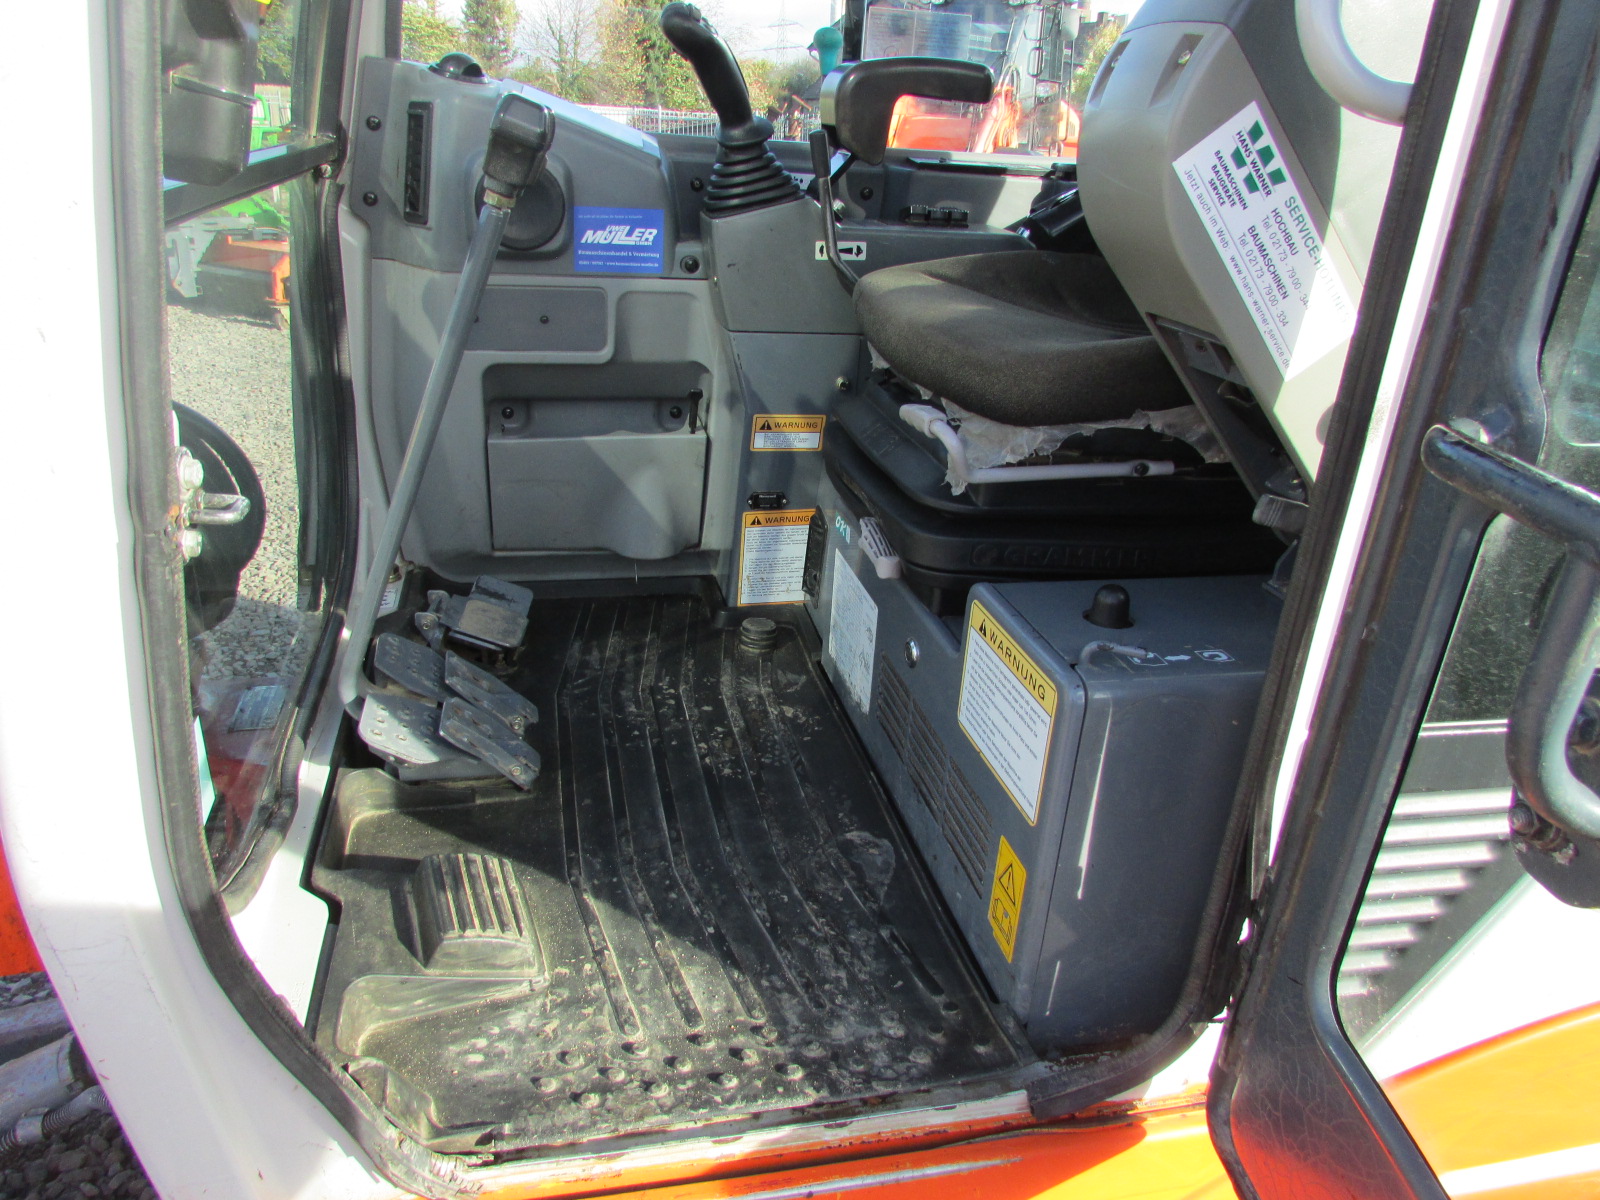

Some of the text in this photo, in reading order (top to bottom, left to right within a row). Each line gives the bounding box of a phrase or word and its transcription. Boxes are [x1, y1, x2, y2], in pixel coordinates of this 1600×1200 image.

[1210, 162, 1238, 208] BAUGERÄTE
[1213, 149, 1248, 211] BAUMASCHINEN
[1235, 129, 1272, 198] HANS WARNER
[1183, 167, 1200, 192] Jetzt
[1196, 191, 1212, 215] auch
[1208, 214, 1218, 228] im
[1207, 177, 1226, 207] SERVICE
[1260, 215, 1273, 233] Tel.
[1270, 207, 1299, 257] HOCHBAU
[1237, 232, 1249, 250] Tel.
[1275, 309, 1289, 328] 334
[1246, 224, 1289, 301] BAUMASCHINEN
[774, 421, 818, 429] WARNUNG
[765, 515, 810, 524] WARNUNG
[989, 627, 1046, 701] WARNUNG
